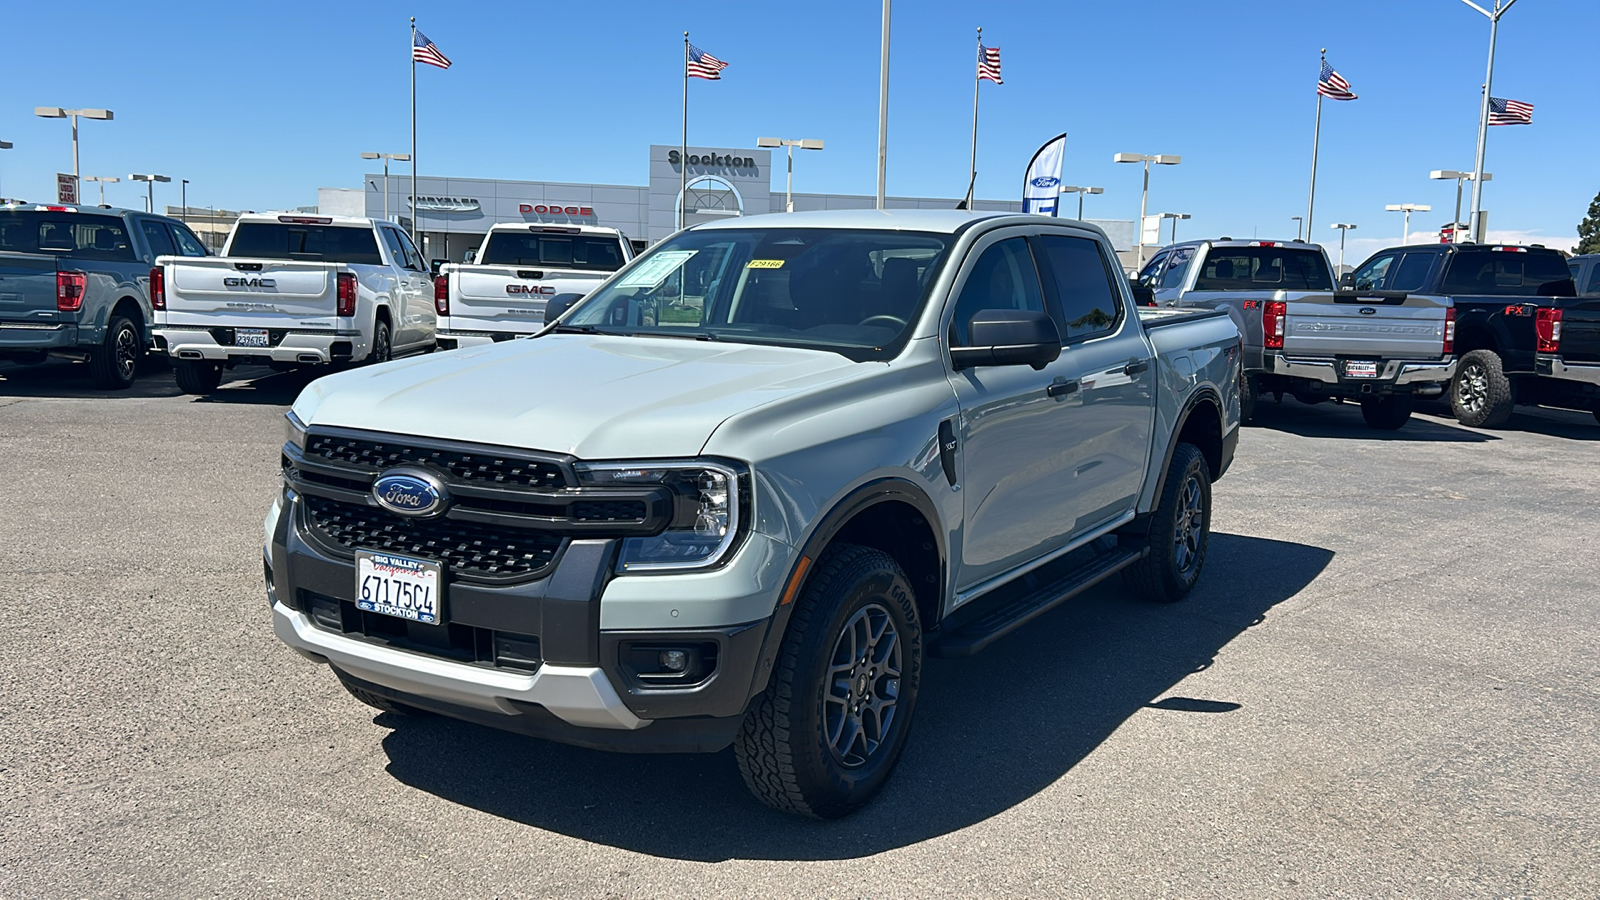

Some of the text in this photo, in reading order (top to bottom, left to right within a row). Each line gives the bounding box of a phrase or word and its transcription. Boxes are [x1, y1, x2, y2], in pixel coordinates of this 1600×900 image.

[668, 150, 754, 168] Stockton
[1035, 178, 1056, 187] Ford
[60, 193, 75, 202] CARS
[519, 204, 593, 216] DODGE
[224, 277, 278, 287] GMC
[506, 284, 556, 294] GMC
[1243, 299, 1262, 310] FX4
[1505, 305, 1533, 316] FX4
[386, 483, 422, 506] Ford
[374, 555, 419, 569] BIG VALLEY
[362, 575, 433, 613] 67175C4
[374, 604, 419, 619] STOCKTON
[892, 585, 922, 691] GOODYEAR
